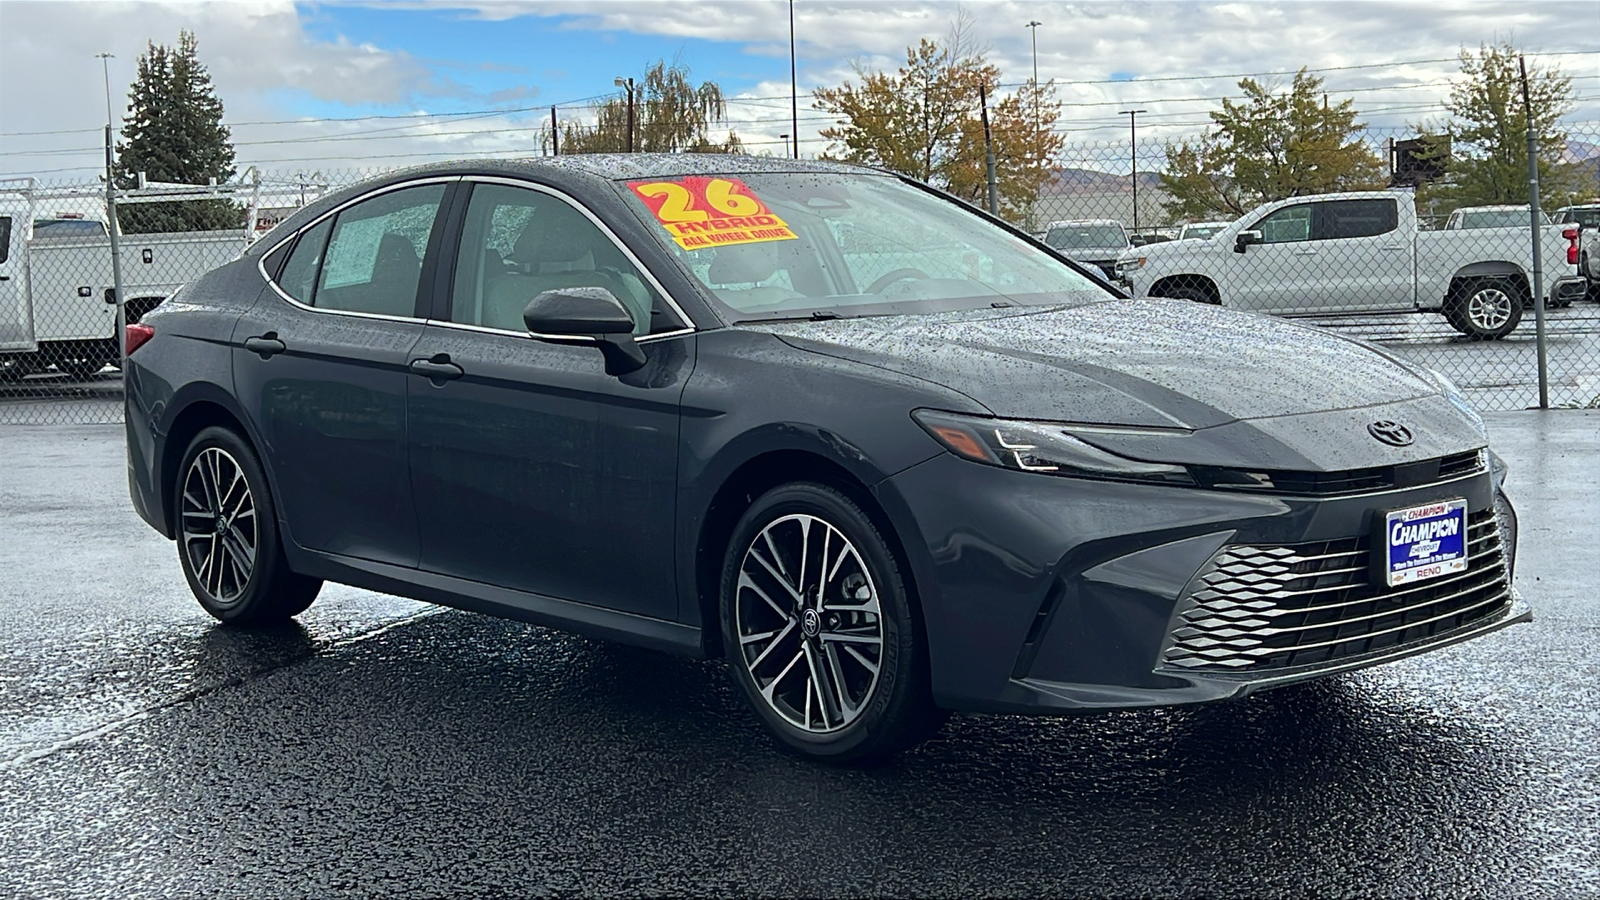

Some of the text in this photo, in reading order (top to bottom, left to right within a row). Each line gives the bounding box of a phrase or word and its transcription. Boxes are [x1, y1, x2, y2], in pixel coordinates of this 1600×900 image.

[637, 179, 763, 222] 26
[675, 215, 778, 234] HYBRID
[682, 227, 791, 247] ALL WHEEL DRIVE
[1408, 505, 1446, 519] CHAMPION
[1391, 517, 1459, 547] CHAMPION
[1417, 566, 1442, 578] RENO
